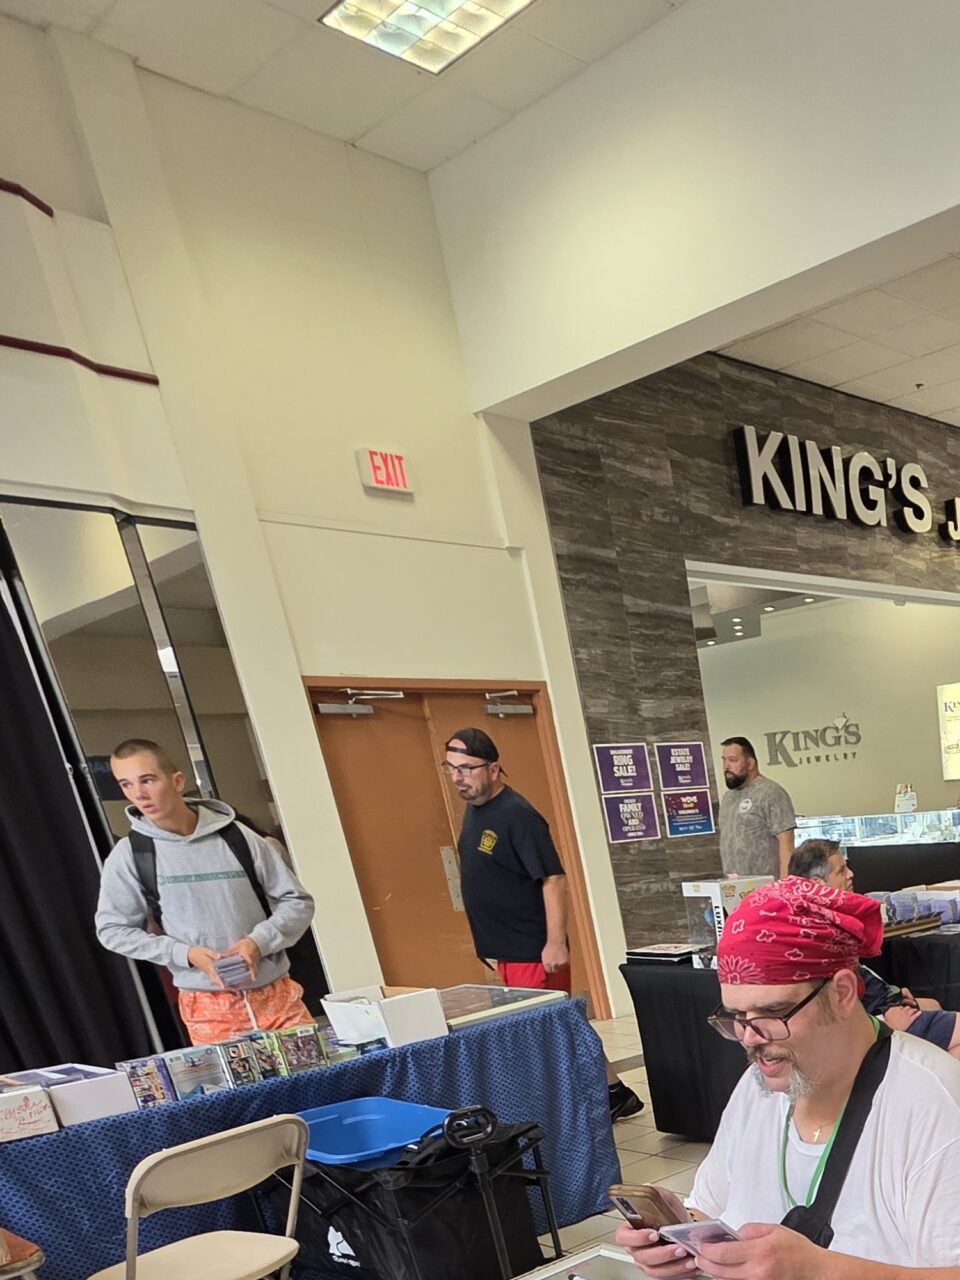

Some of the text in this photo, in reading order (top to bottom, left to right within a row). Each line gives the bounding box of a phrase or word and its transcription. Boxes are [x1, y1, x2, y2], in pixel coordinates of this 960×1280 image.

[368, 450, 408, 489] EXIT
[741, 424, 933, 534] KING'S
[764, 713, 862, 768] KING'S
[613, 755, 634, 766] RING
[798, 751, 858, 765] JEWELRY
[613, 766, 637, 777] SALE!
[619, 803, 642, 813] FAMILY
